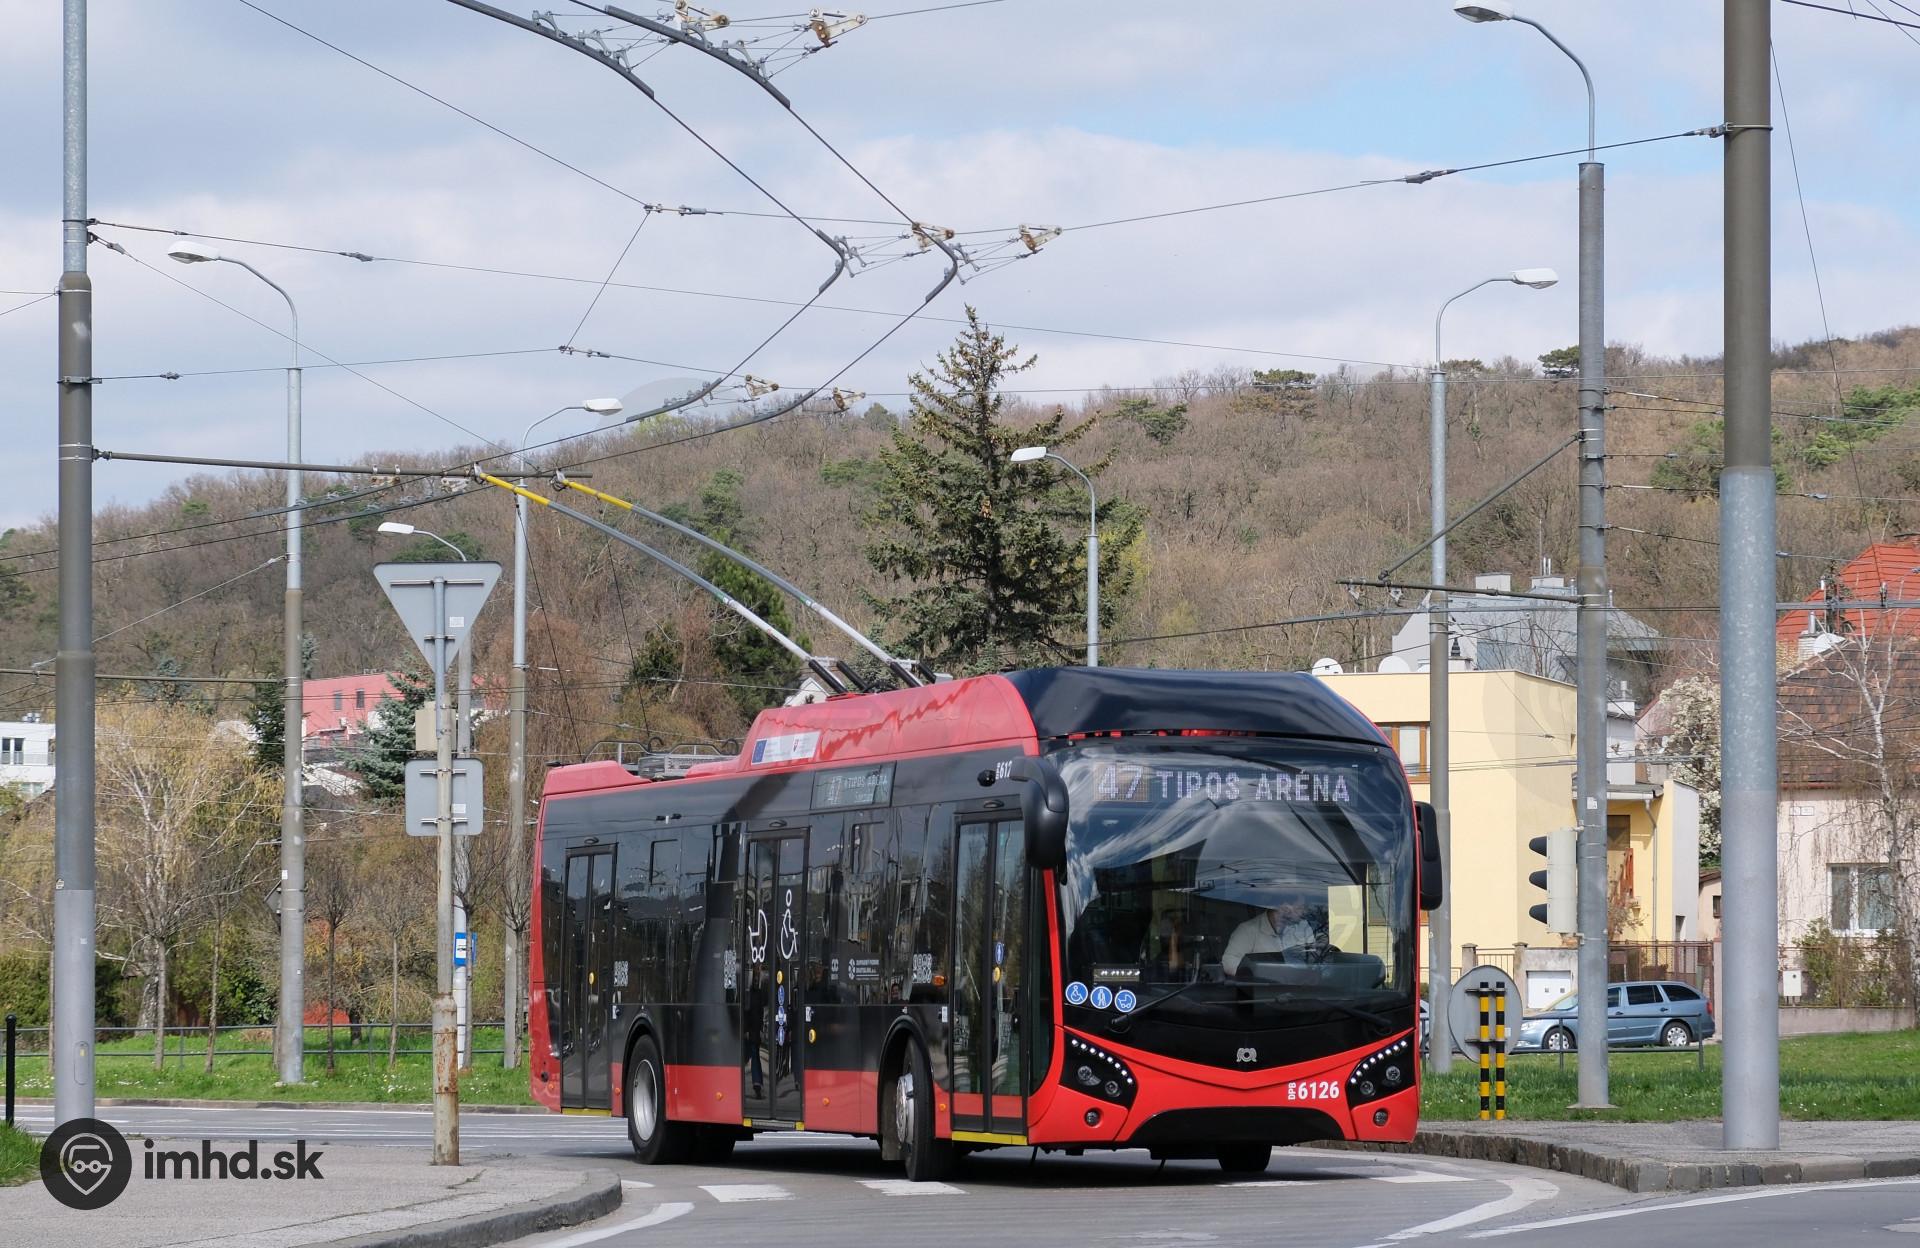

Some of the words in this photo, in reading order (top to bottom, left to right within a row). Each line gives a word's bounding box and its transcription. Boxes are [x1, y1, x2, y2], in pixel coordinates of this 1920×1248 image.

[1098, 765, 1143, 799] 47
[1156, 770, 1240, 800] TIPOS
[1255, 769, 1350, 802] ARÉNA
[1287, 1082, 1297, 1101] DPB
[1298, 1081, 1340, 1100] 6126
